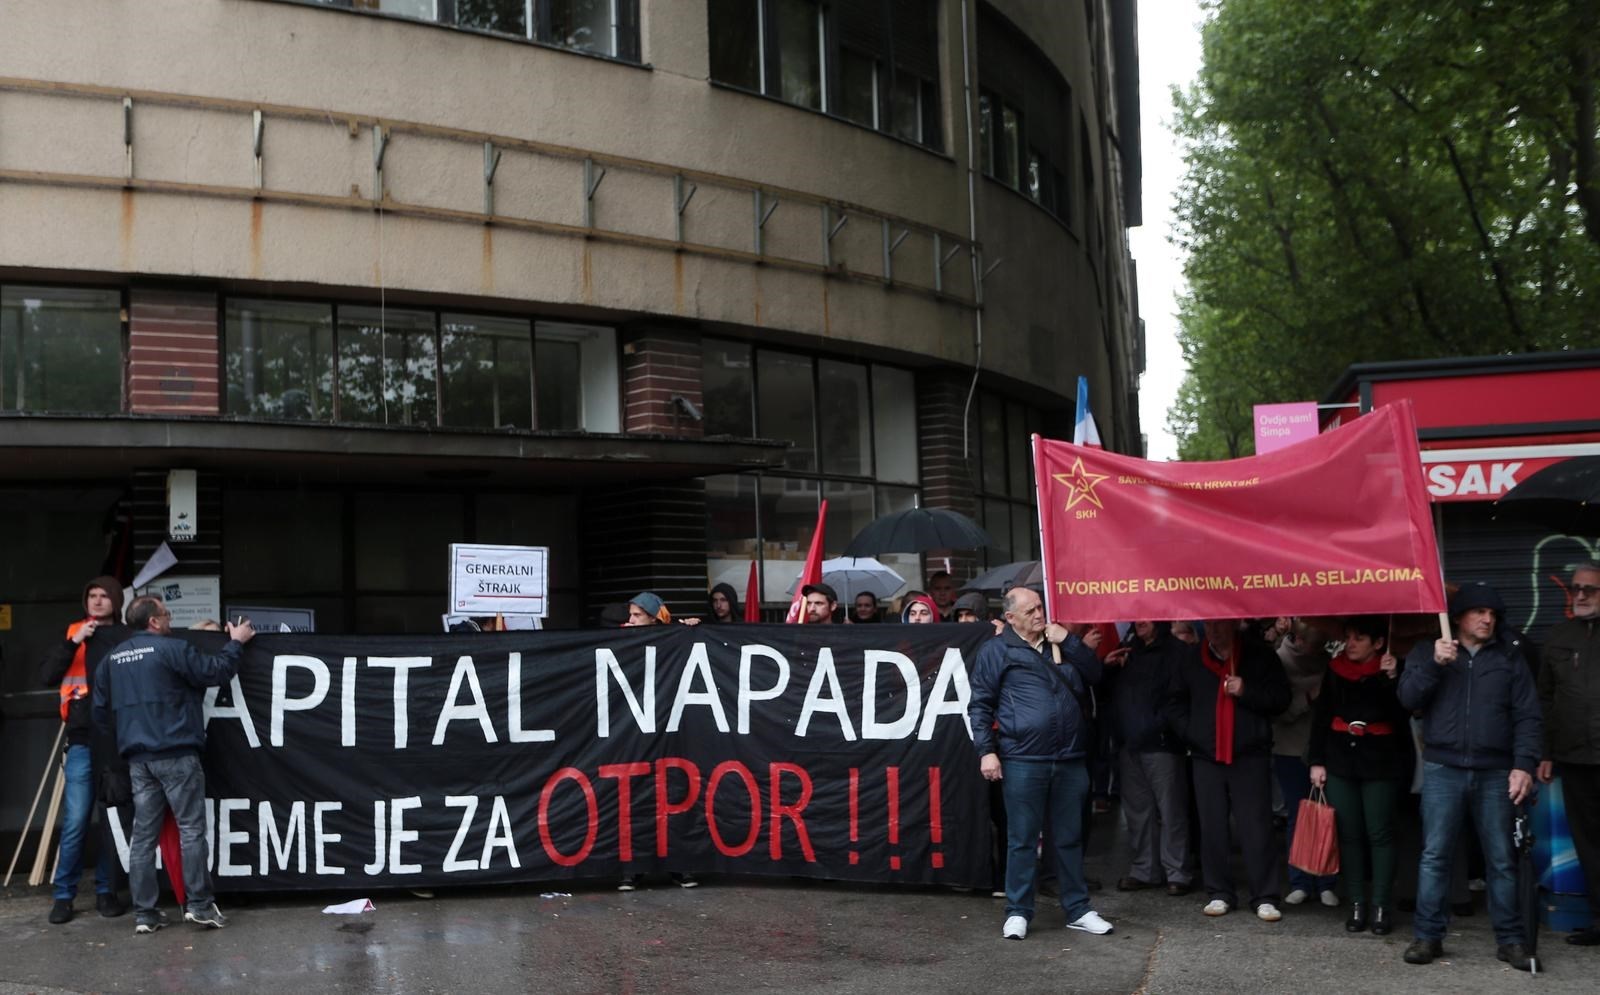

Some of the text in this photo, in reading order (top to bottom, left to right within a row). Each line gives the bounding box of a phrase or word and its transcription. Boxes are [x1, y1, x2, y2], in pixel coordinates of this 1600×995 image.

[1260, 415, 1288, 426] Ovdje
[1289, 413, 1312, 424] sam!
[1260, 427, 1290, 437] Simpa
[1204, 477, 1260, 490] HRVATSKE
[1423, 462, 1524, 497] SAK
[1075, 510, 1097, 520] SKH
[465, 563, 534, 576] GENERALNI
[478, 579, 521, 594] ŠTRAJK
[1055, 567, 1424, 596] TVORNICE RADNICIMA, ZEMLJA SELJACIMA
[202, 642, 974, 749] APITAL NAPADA
[363, 795, 423, 876] JE
[442, 795, 521, 872] ZA
[538, 757, 817, 867] OTPOR
